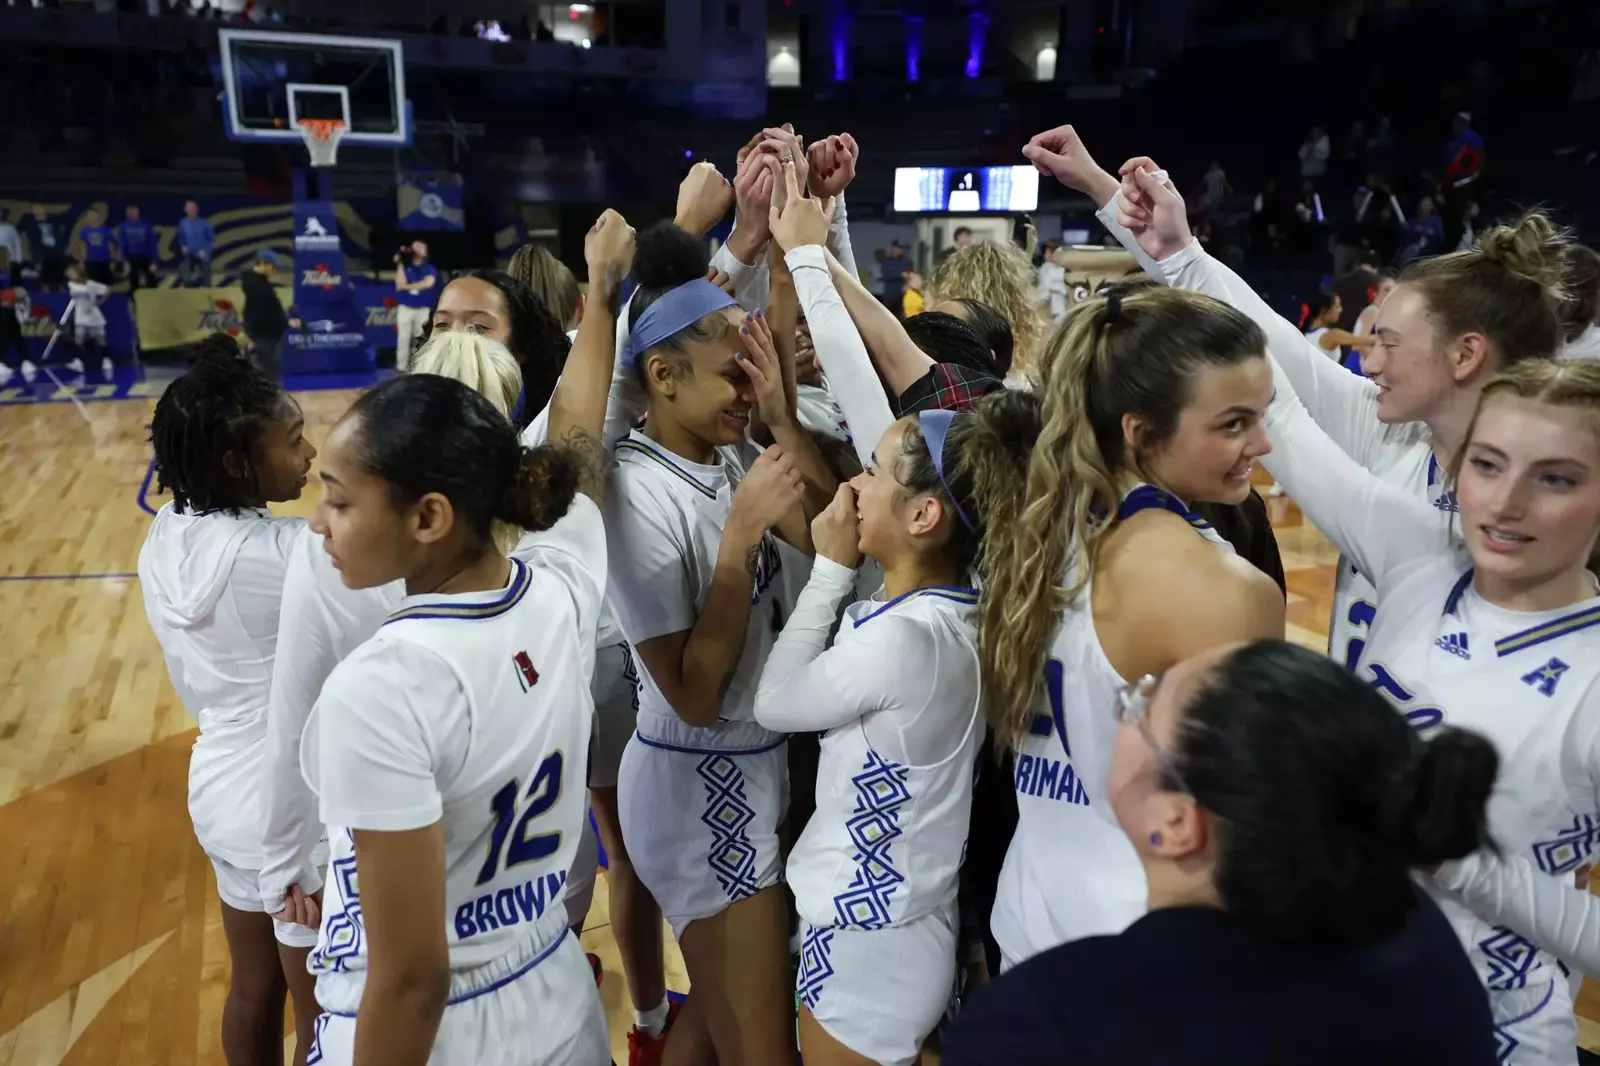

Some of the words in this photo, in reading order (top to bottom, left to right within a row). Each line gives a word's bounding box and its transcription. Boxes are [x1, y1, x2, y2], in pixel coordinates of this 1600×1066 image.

[365, 306, 398, 327] Tul
[1435, 638, 1472, 660] adidas
[475, 749, 564, 887] 12
[454, 869, 567, 940] BROWN
